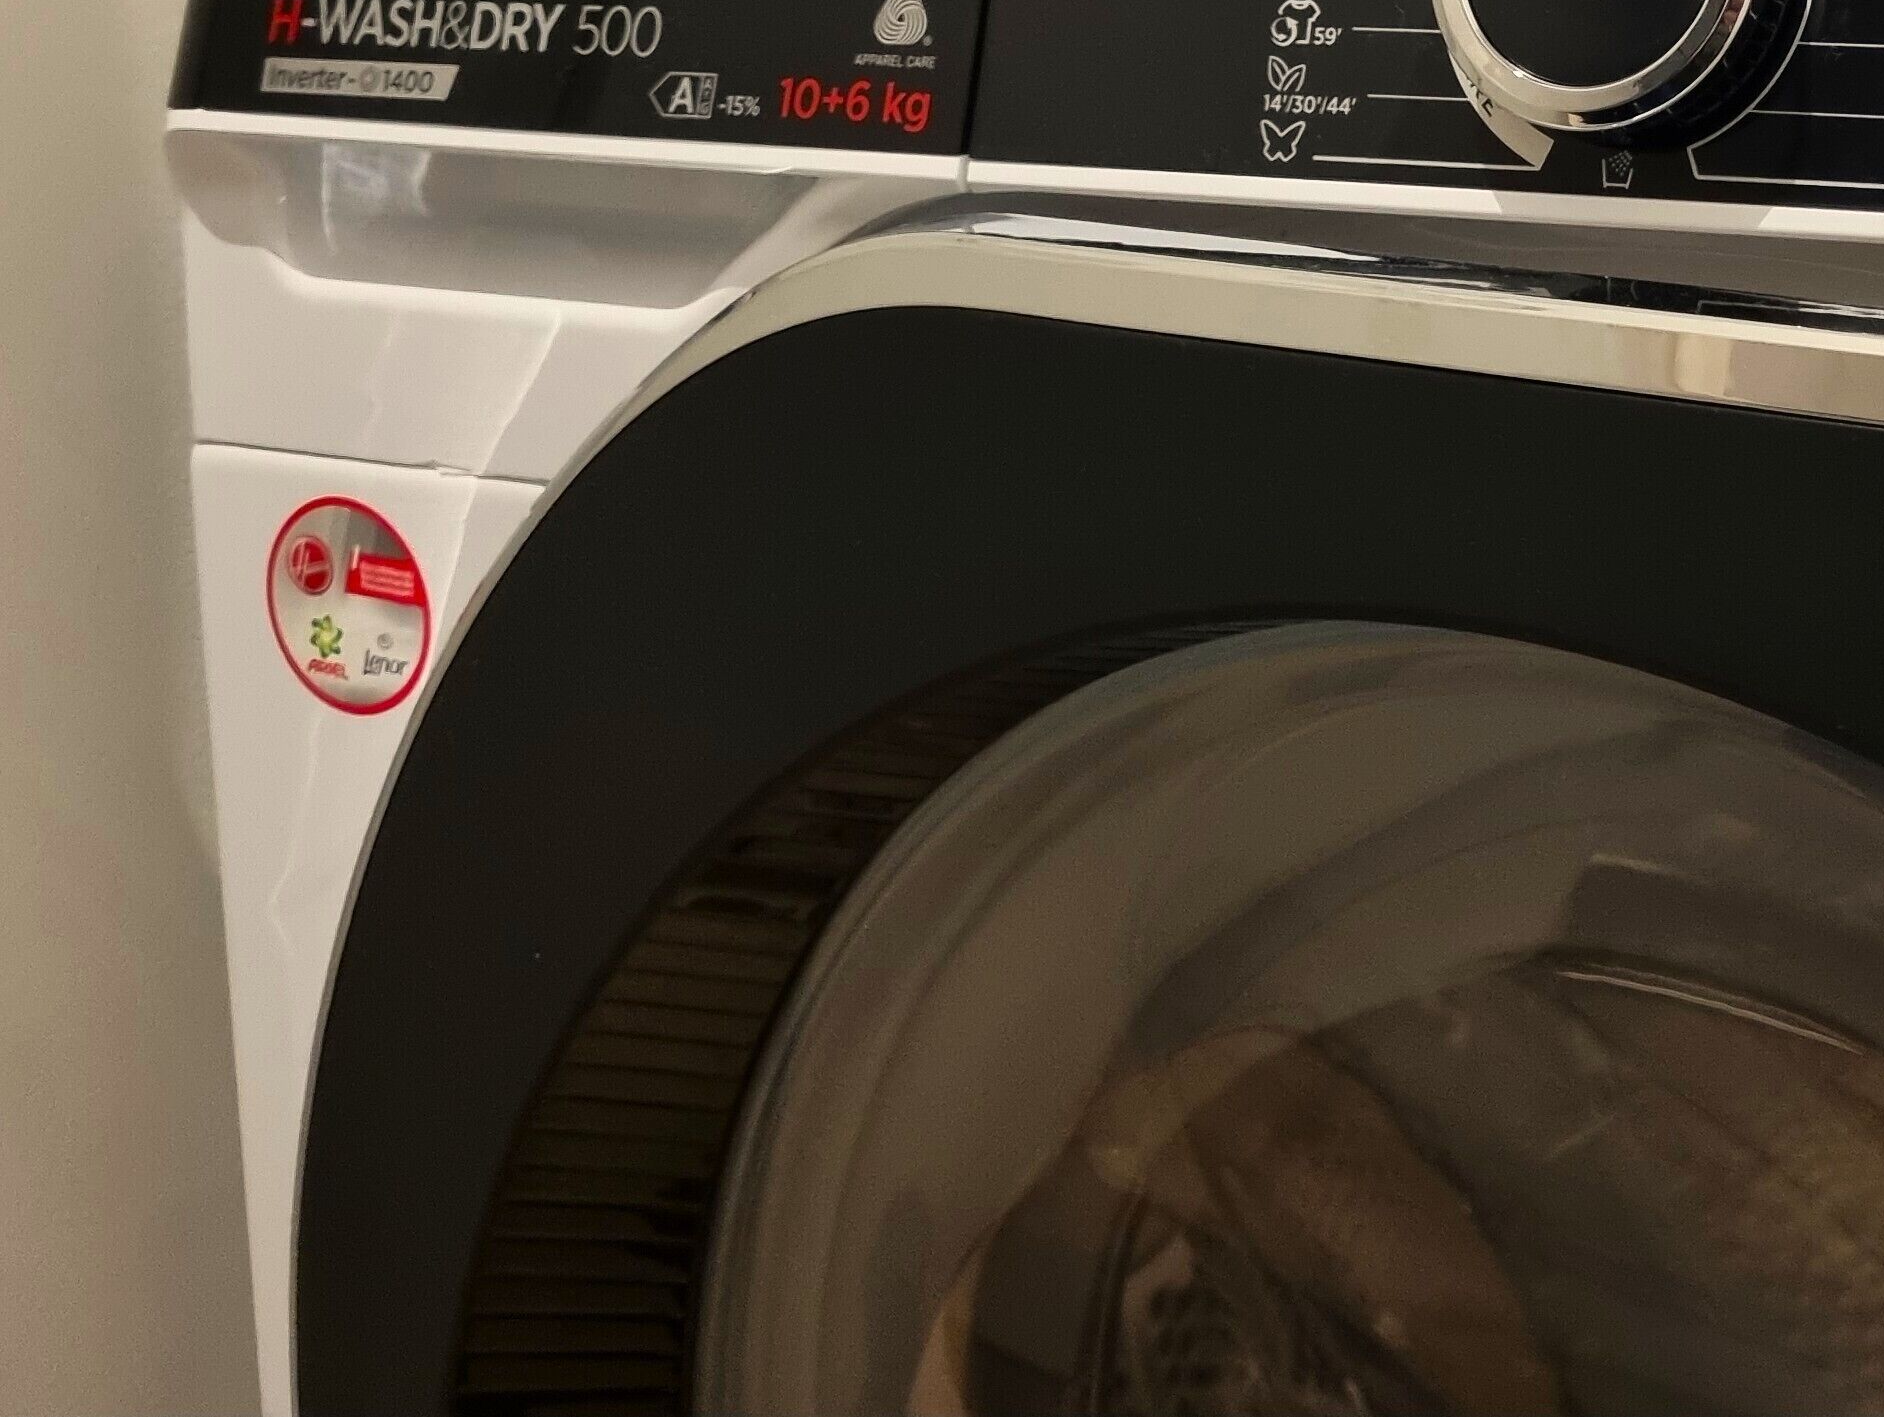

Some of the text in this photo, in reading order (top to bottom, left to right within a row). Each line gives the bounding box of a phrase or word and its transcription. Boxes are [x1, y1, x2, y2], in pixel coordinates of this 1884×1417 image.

[572, 5, 663, 58] 500
[1312, 26, 1343, 45] 59'
[855, 53, 936, 70] APPAREL CARE
[382, 69, 436, 94] 1400
[667, 75, 695, 114] A
[717, 94, 760, 117] -15%
[779, 76, 872, 122] 10+6
[881, 81, 932, 133] kg
[1262, 92, 1357, 116] 14'/30'/44'
